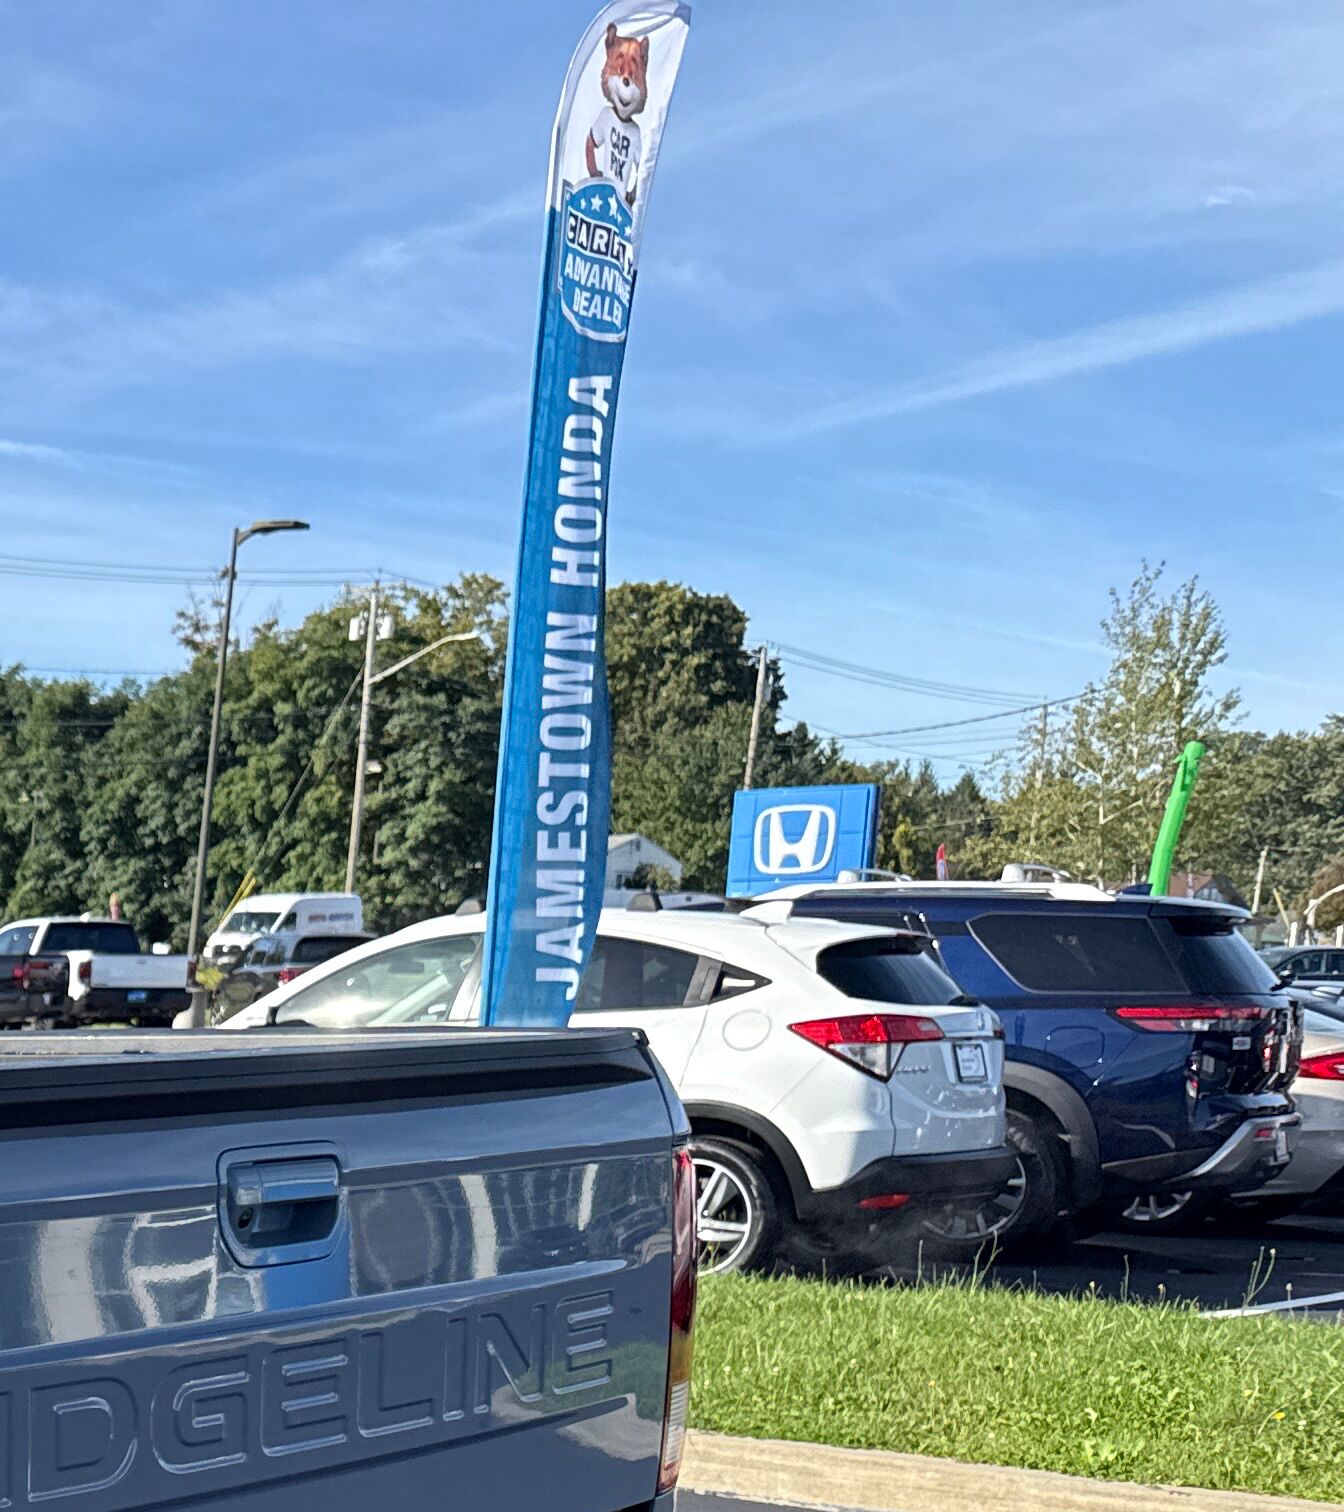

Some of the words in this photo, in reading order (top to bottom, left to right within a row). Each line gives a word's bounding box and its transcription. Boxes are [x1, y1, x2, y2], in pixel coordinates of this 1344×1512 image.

[610, 126, 630, 158] CAR
[567, 214, 633, 277] CARF
[564, 252, 631, 307] ADVANTE
[549, 374, 613, 587] HONDA
[535, 611, 598, 1000] JAMESTOWN
